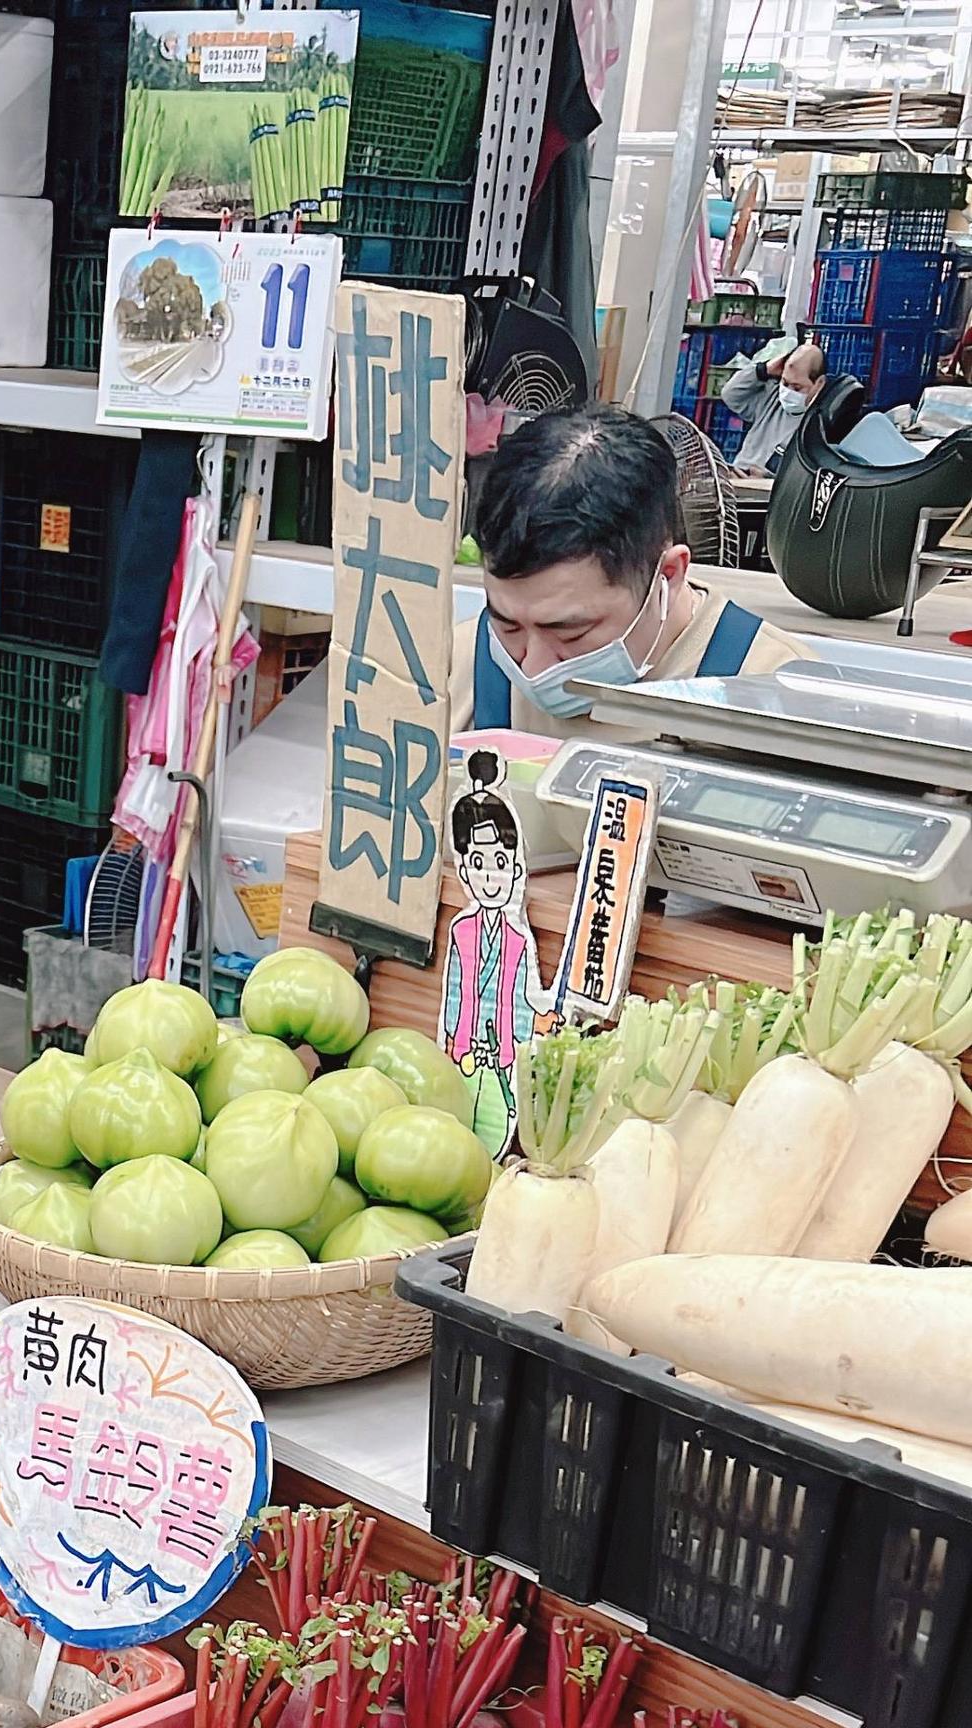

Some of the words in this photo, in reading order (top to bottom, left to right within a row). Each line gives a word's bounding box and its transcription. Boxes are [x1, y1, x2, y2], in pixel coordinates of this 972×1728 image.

[203, 63, 262, 75] 0921-623-766
[208, 49, 259, 60] 03-3240777
[260, 262, 311, 350] 11
[328, 293, 451, 905] 桃太郎
[16, 1402, 234, 1573] 馬鈴薯
